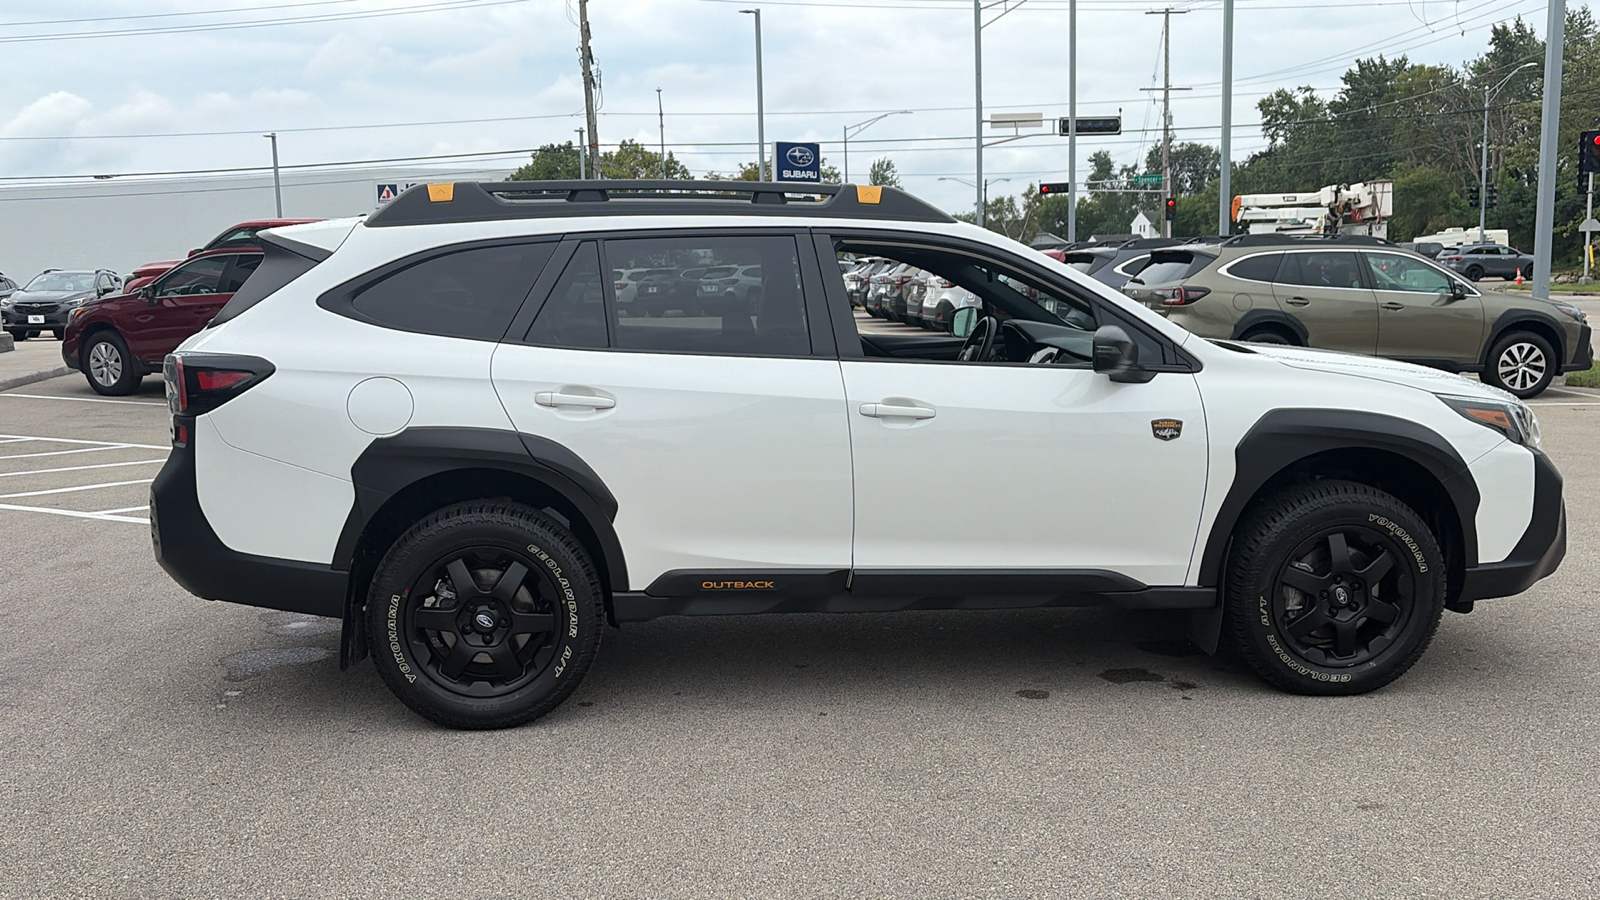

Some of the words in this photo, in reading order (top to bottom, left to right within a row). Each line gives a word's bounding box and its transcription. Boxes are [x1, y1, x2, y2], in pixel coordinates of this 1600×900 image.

[782, 170, 818, 179] SUBARU
[1138, 176, 1158, 184] Spencer
[1368, 513, 1429, 573] YOKOHAMA
[702, 581, 775, 589] OUTBACK
[527, 544, 579, 638] GEOLANDAR
[553, 645, 574, 678] A/T
[1259, 595, 1270, 627] A/T
[387, 594, 416, 684] YOKOHAMA
[1266, 634, 1352, 683] GEOLANDAR
